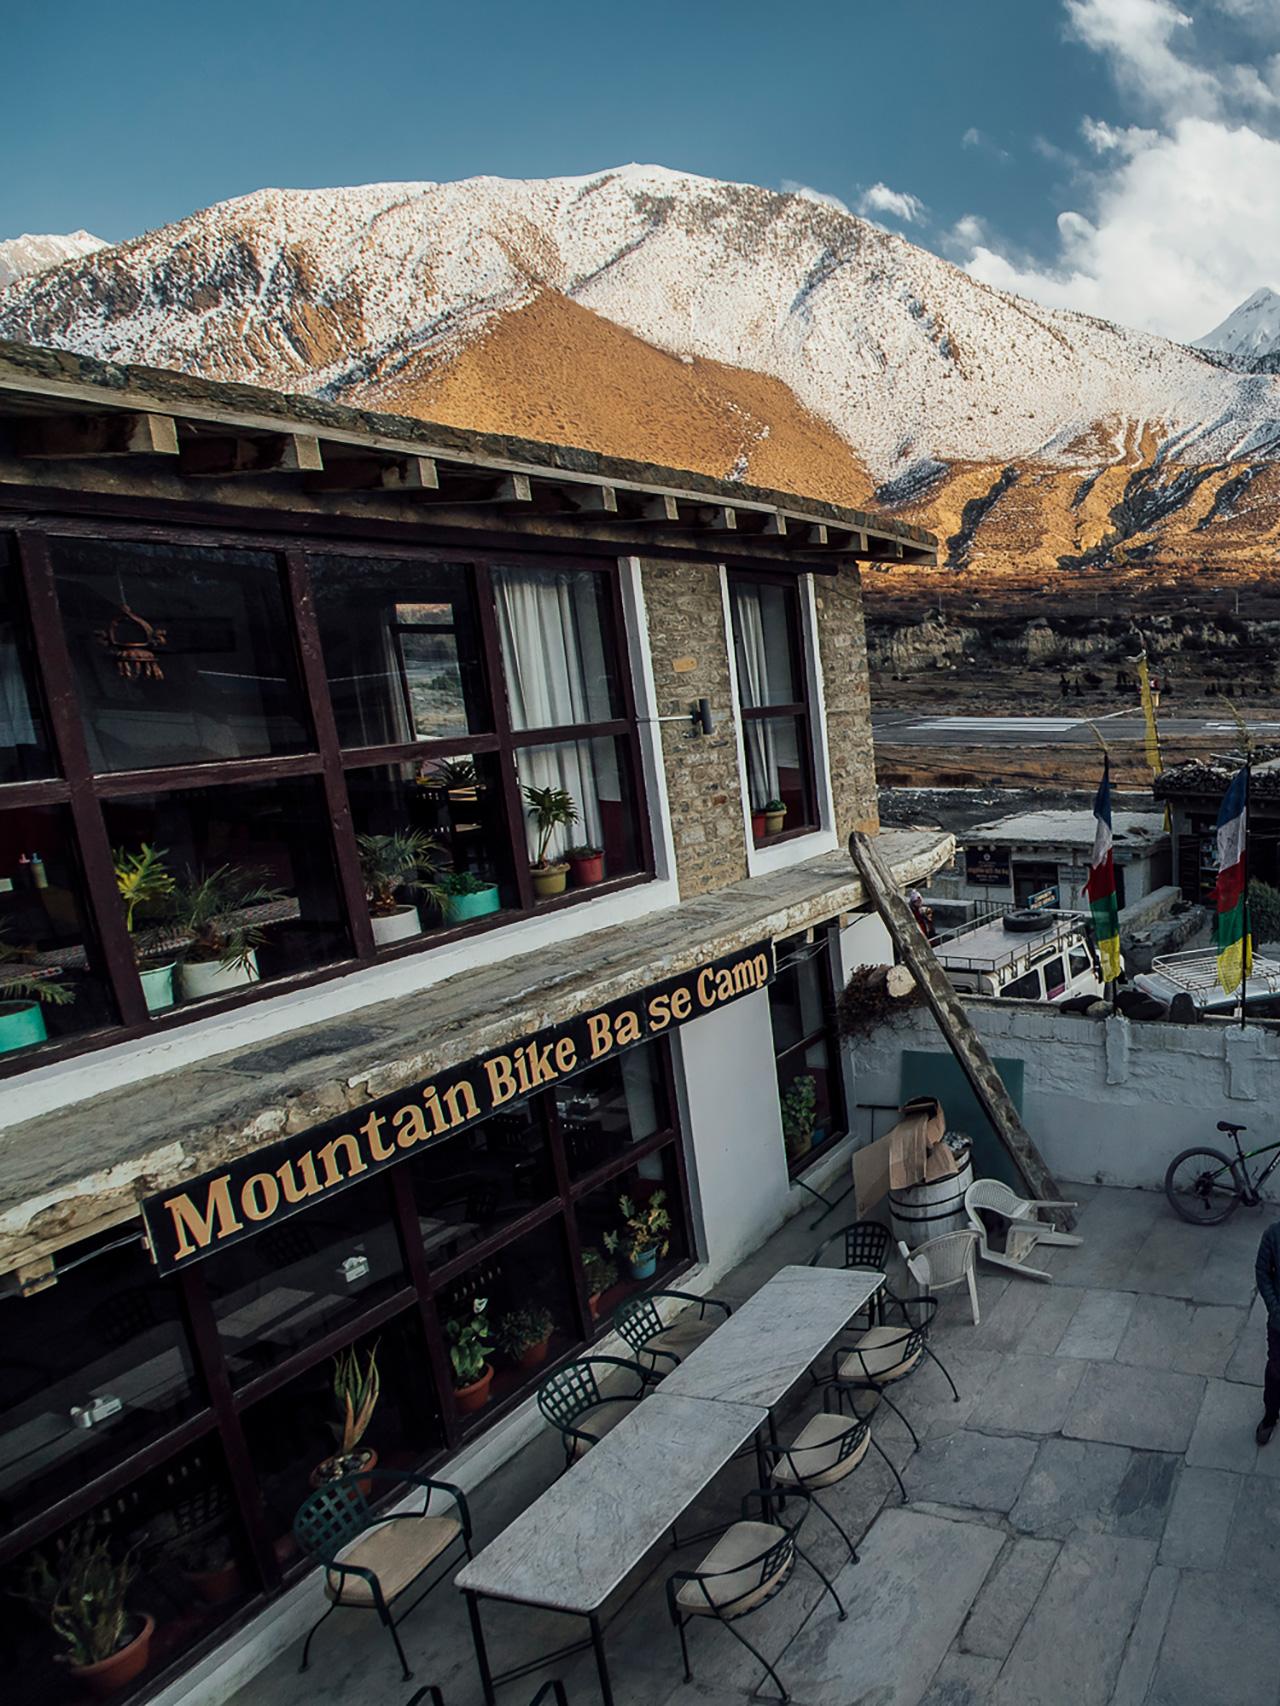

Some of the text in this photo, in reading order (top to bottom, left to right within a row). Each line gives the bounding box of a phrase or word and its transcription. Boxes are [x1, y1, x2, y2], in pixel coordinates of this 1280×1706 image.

[164, 1080, 481, 1261] Mountain
[484, 1036, 577, 1107] Bike
[697, 953, 769, 1009] Camp
